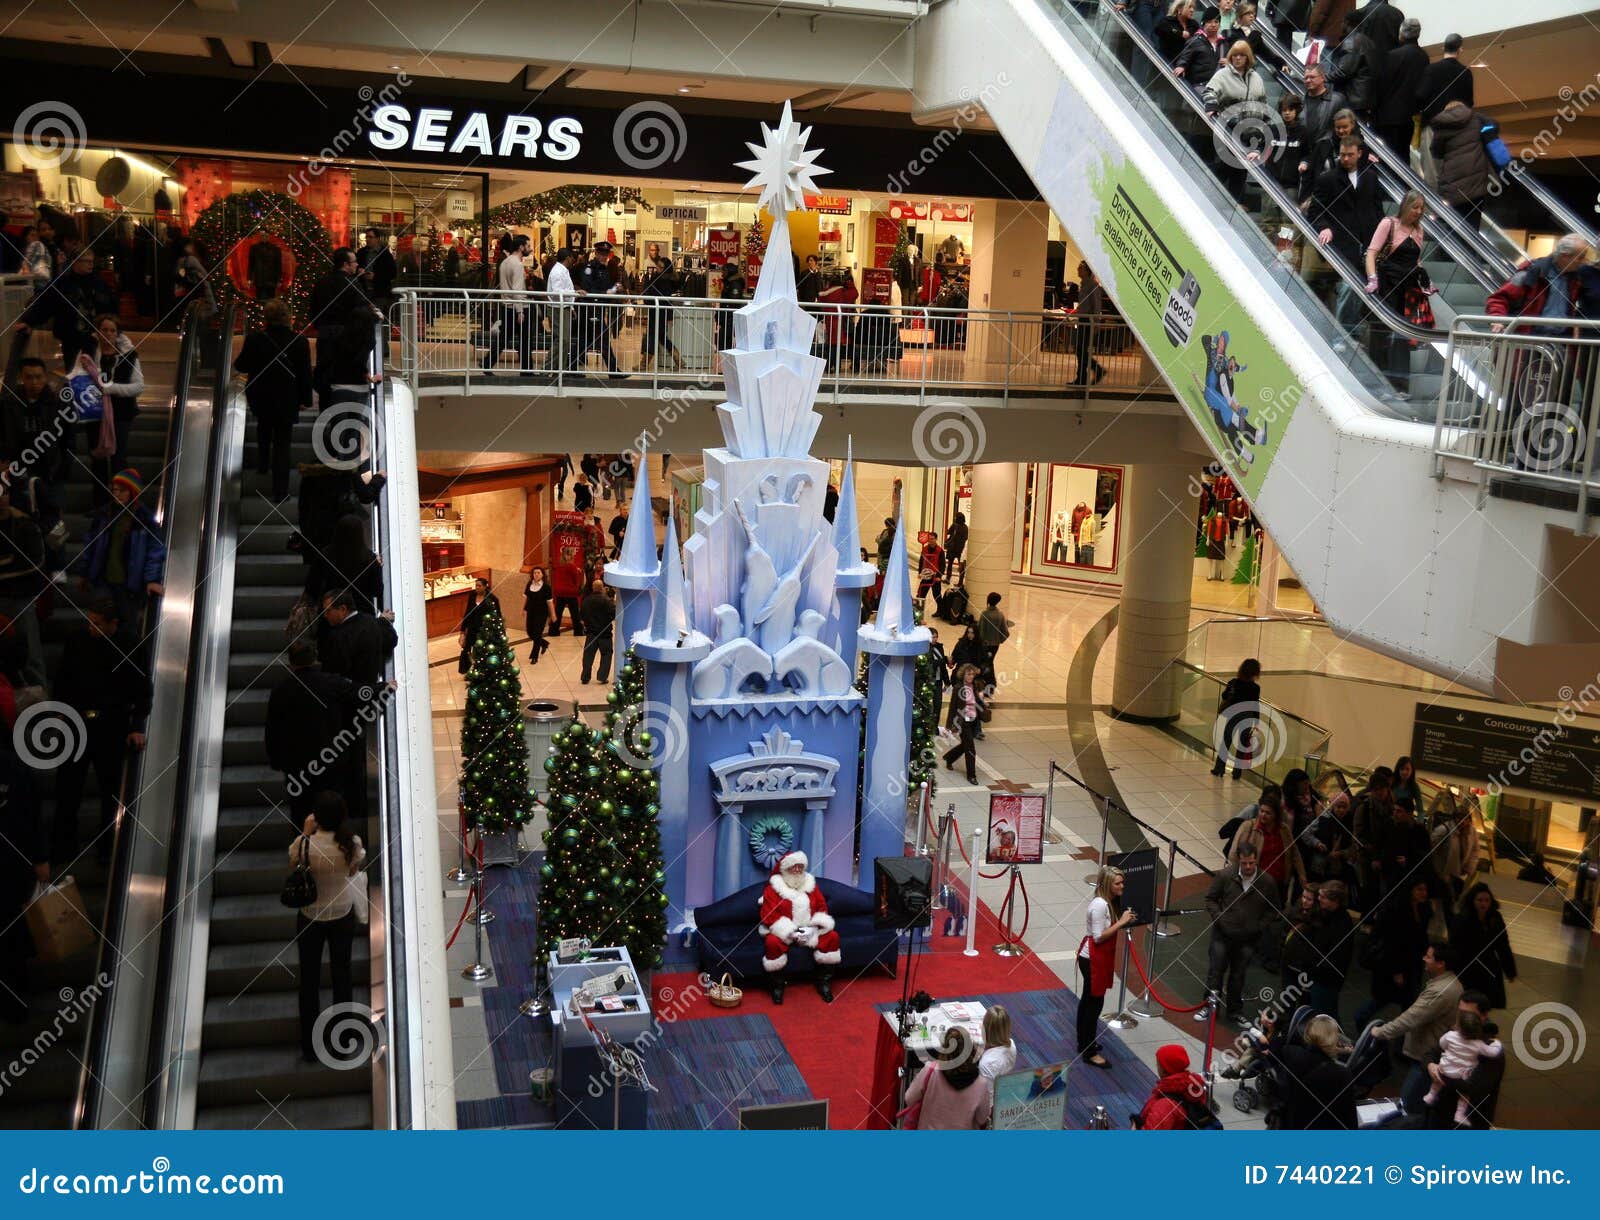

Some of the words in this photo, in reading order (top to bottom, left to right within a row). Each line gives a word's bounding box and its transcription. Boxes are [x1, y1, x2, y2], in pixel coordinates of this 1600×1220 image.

[369, 105, 583, 161] SEARS
[816, 196, 839, 206] SALE
[662, 208, 699, 219] OPTICAL
[1111, 193, 1131, 225] Don't
[1129, 222, 1143, 243] get
[1141, 235, 1154, 256] hit
[1151, 247, 1162, 270] by
[1161, 266, 1172, 284] an
[711, 241, 739, 257] super
[1104, 220, 1137, 269] avalanche
[1137, 267, 1147, 280] of
[1145, 274, 1162, 307] fees.
[1484, 717, 1538, 734] Concourse
